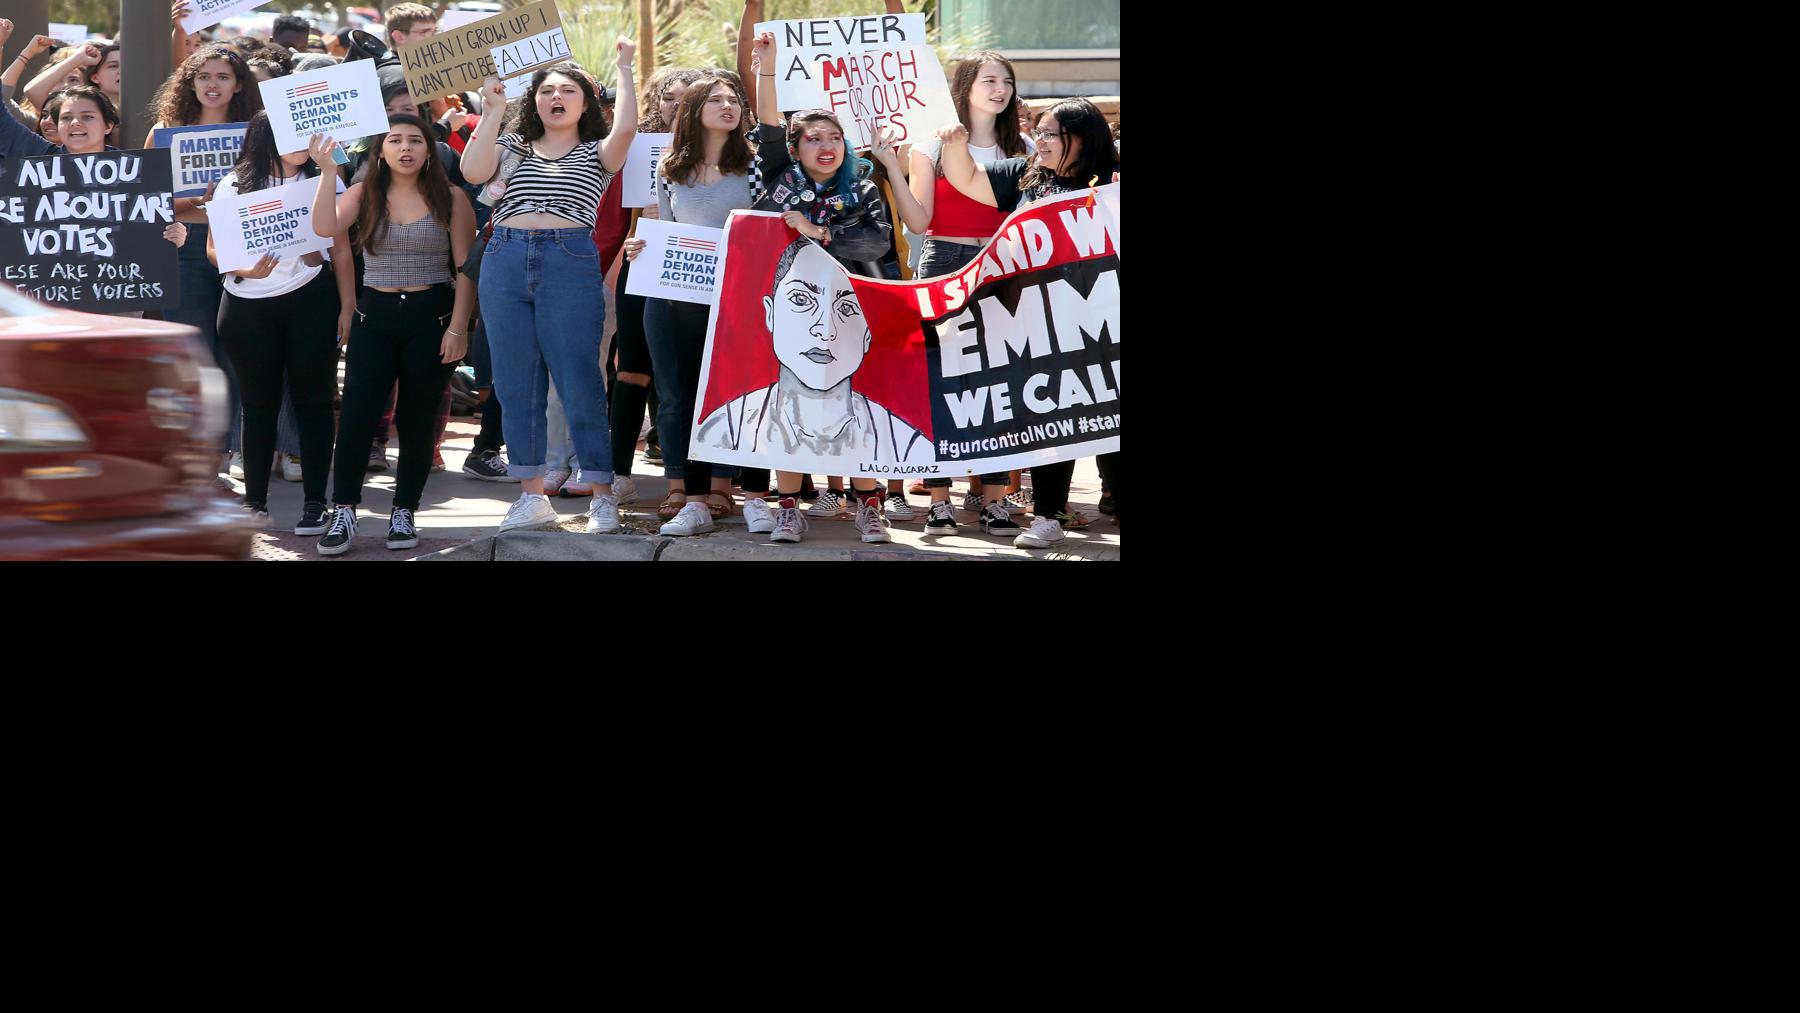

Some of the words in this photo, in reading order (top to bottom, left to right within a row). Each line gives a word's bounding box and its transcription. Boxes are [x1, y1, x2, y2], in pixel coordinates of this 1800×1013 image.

[404, 38, 455, 71] WHEN
[457, 35, 464, 55] I
[466, 22, 508, 49] GROW
[509, 13, 531, 38] UP
[539, 7, 548, 26] I
[785, 15, 906, 47] NEVER
[410, 68, 453, 98] WANT
[454, 61, 478, 83] TO
[477, 54, 499, 78] BE
[822, 49, 918, 91] MARCH
[288, 89, 359, 112] STUDENTS
[829, 87, 870, 118] FOR
[871, 80, 926, 115] OUR
[291, 102, 347, 122] DEMAND
[295, 113, 342, 132] ACTION
[179, 135, 244, 154] MARCH
[18, 156, 66, 189] ALL
[73, 155, 140, 185] YOU
[180, 153, 217, 170] FOR
[219, 151, 241, 167] OU
[34, 191, 127, 222] ABOUT
[129, 192, 174, 223] ARE
[241, 206, 309, 230] STUDENTS
[22, 223, 114, 257] VOTES
[243, 219, 299, 240] DEMAND
[246, 231, 294, 250] ACTION
[662, 259, 716, 275] DEMAN
[664, 249, 719, 265] STUDE
[915, 287, 936, 318] I
[943, 217, 1054, 311] STAND
[0, 264, 39, 279] ESE
[51, 263, 88, 282] ARE
[97, 263, 144, 281] YOUR
[660, 271, 716, 286] ACTION
[92, 282, 164, 301] VOTERS
[943, 382, 1014, 430] WE
[938, 418, 1075, 459] #guncontrolNOW
[859, 462, 889, 473] LALO
[893, 465, 940, 474] ALCARAZ
